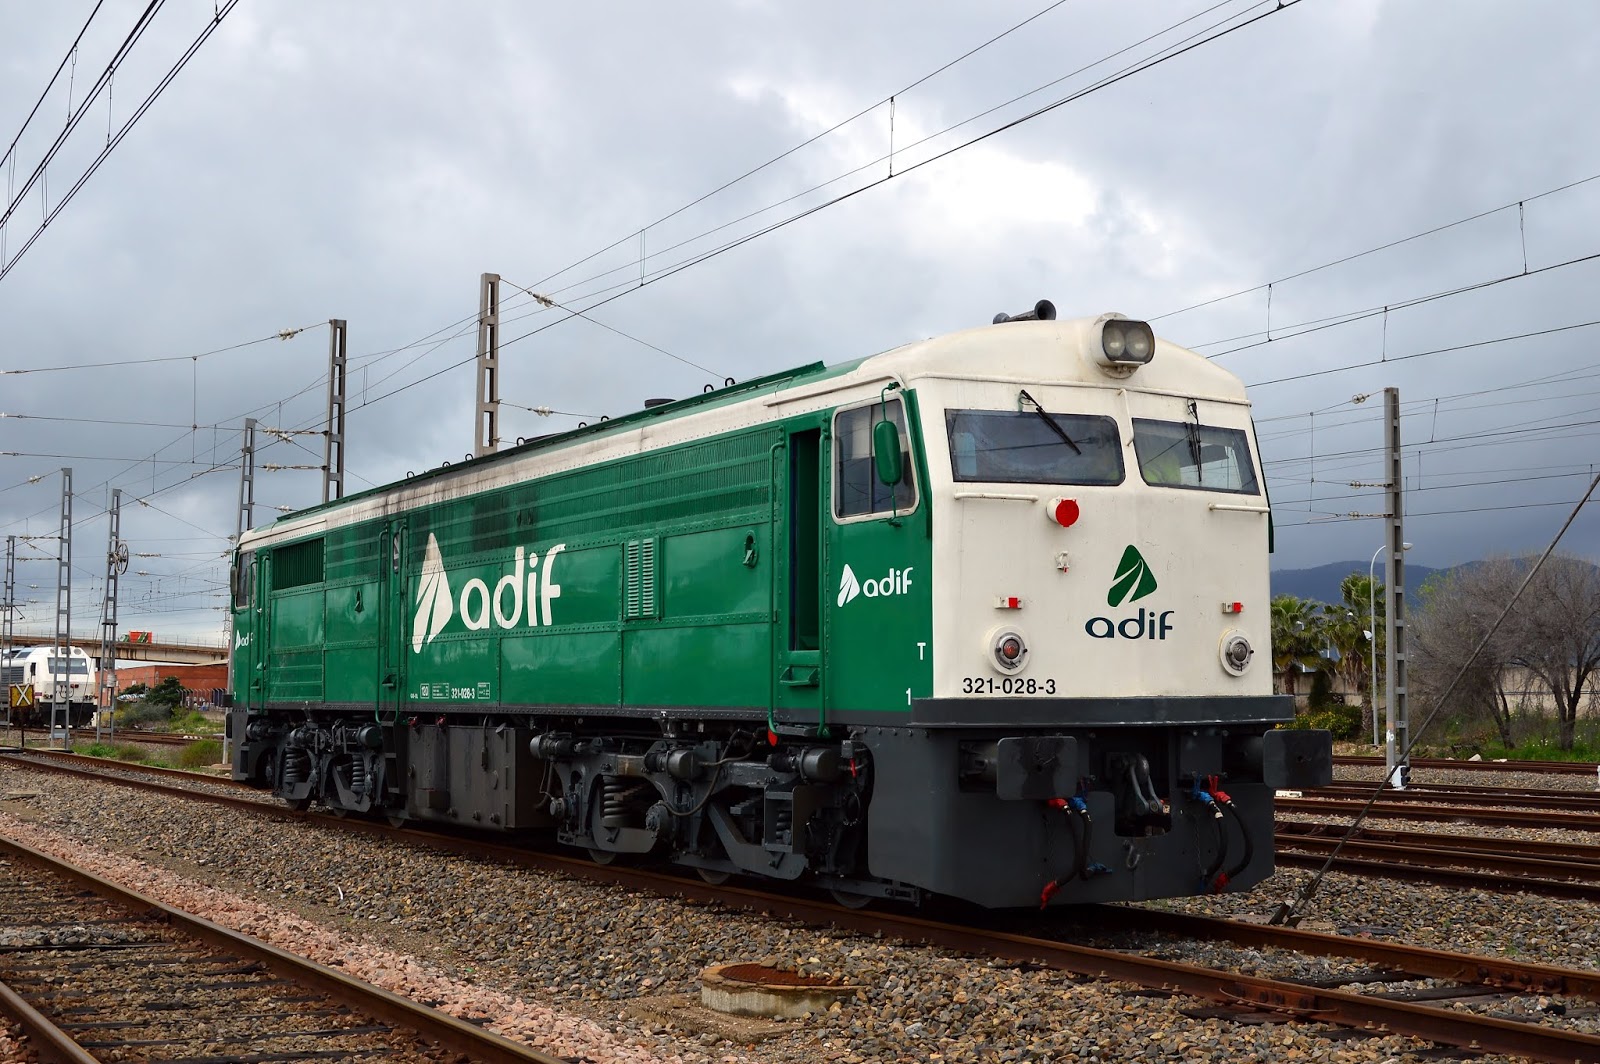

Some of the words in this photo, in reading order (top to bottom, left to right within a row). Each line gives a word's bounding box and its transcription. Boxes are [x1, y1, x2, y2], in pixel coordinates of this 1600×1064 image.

[460, 544, 567, 631] adif
[863, 567, 914, 598] adif
[1085, 607, 1175, 641] adif
[917, 642, 926, 661] T
[451, 687, 475, 699] 321-028-3
[962, 677, 1057, 695] 321-028-3
